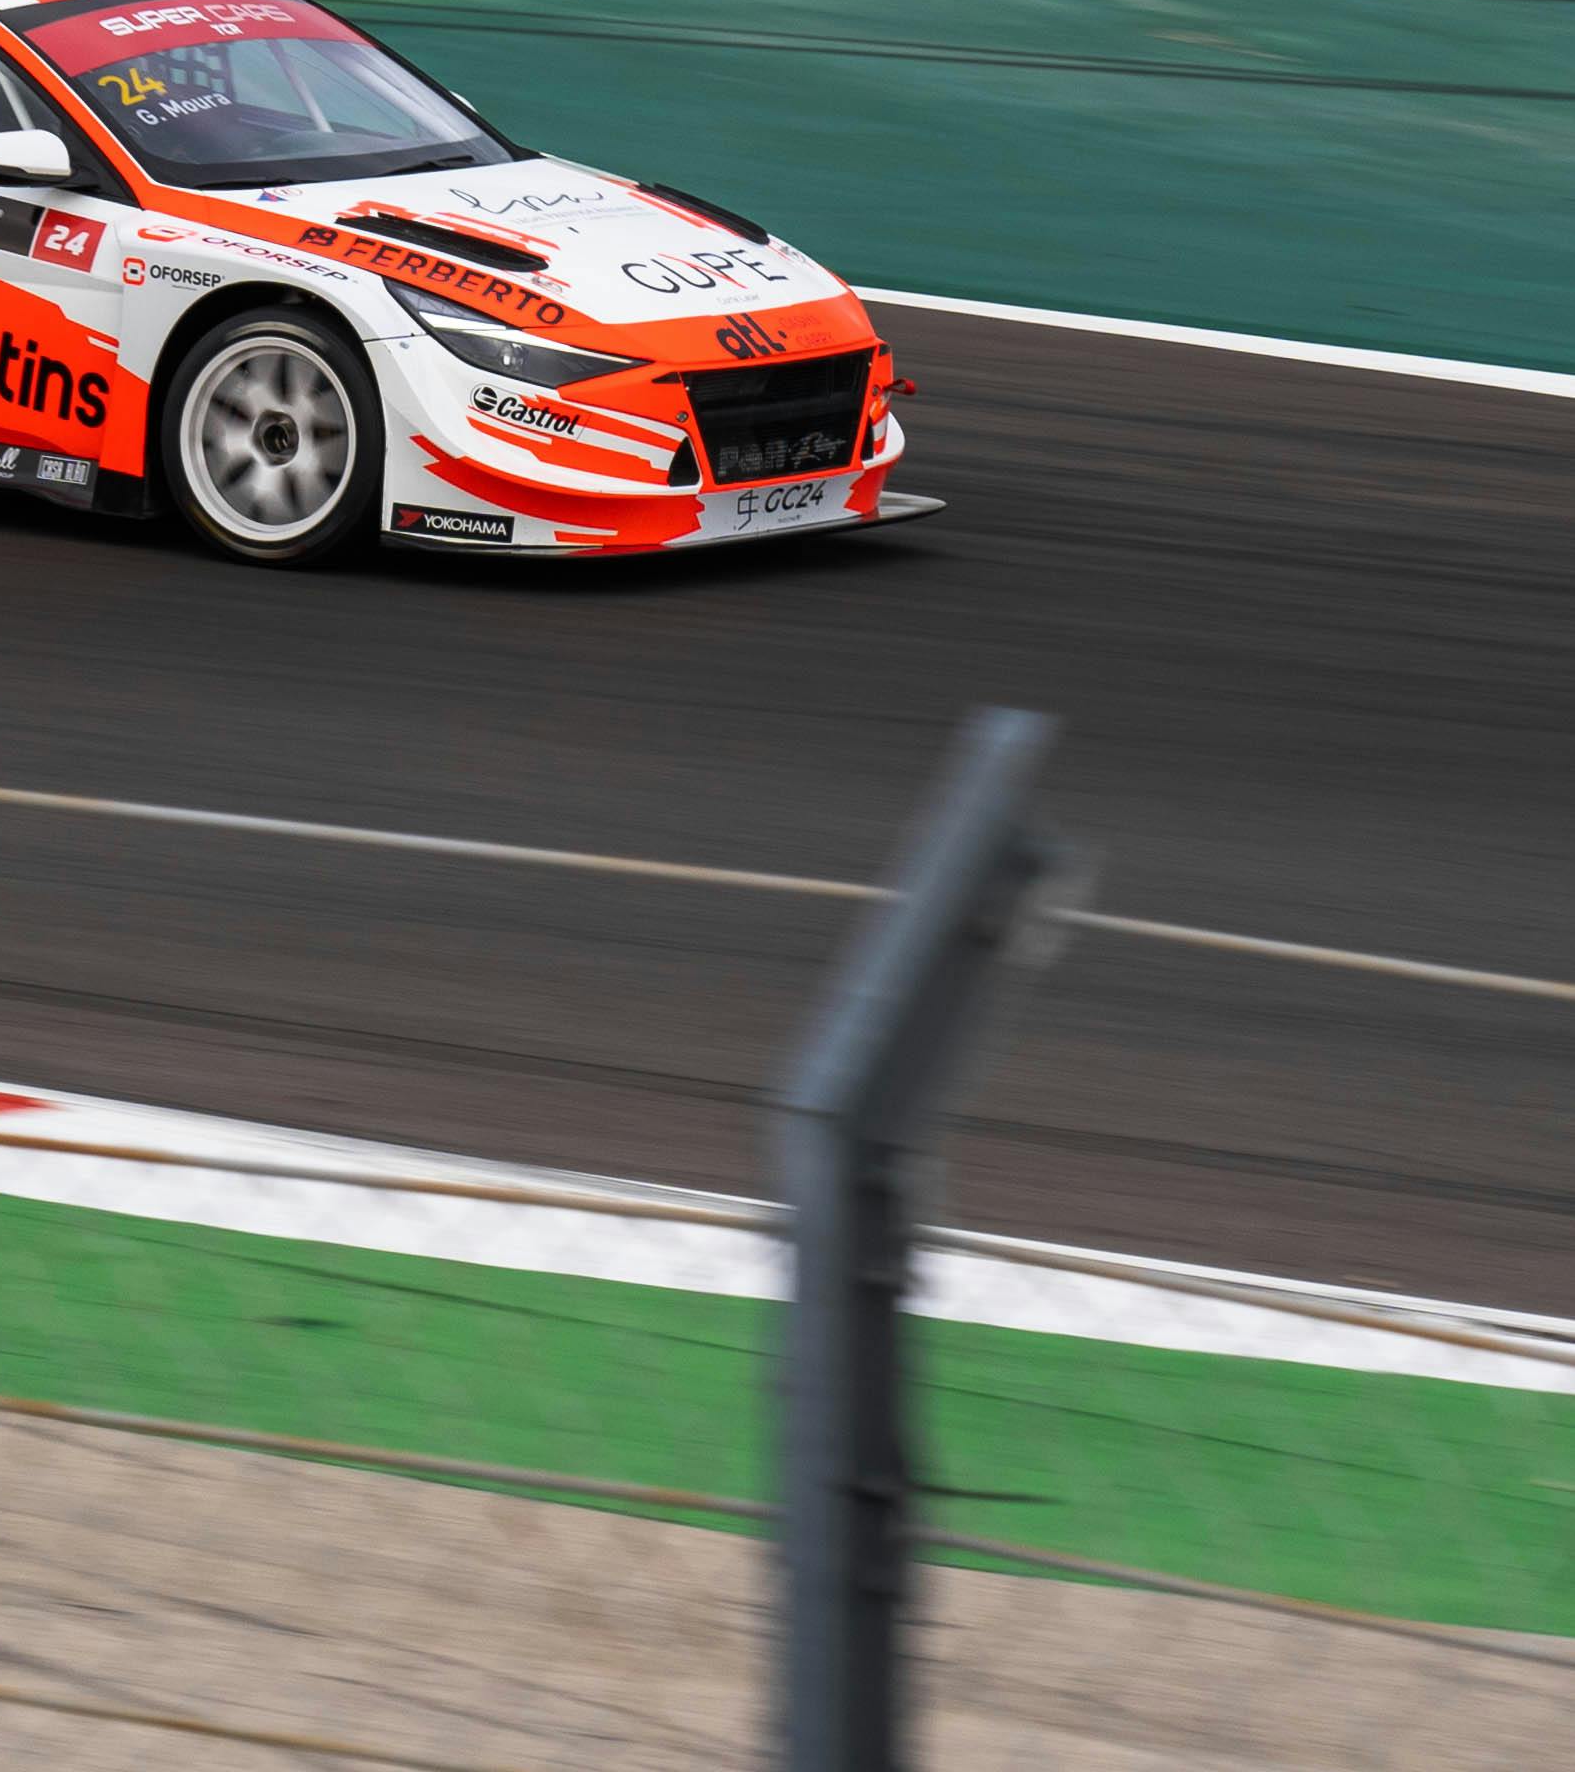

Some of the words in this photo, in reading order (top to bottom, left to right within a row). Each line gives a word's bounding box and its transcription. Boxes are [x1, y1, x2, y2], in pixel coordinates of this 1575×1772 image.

[99, 5, 210, 36] SUPER
[204, 3, 296, 23] CARS
[210, 23, 243, 36] TCR
[98, 68, 168, 106] 24
[136, 108, 167, 126] G.
[159, 92, 233, 118] Moura
[43, 224, 90, 256] 24
[201, 234, 350, 282] OFORSEP
[149, 264, 222, 288] OFORSEP
[343, 237, 565, 326] FERBERTO
[496, 396, 582, 436] Castrol
[764, 480, 826, 514] GC24
[423, 514, 507, 537] YOKOHAMA
